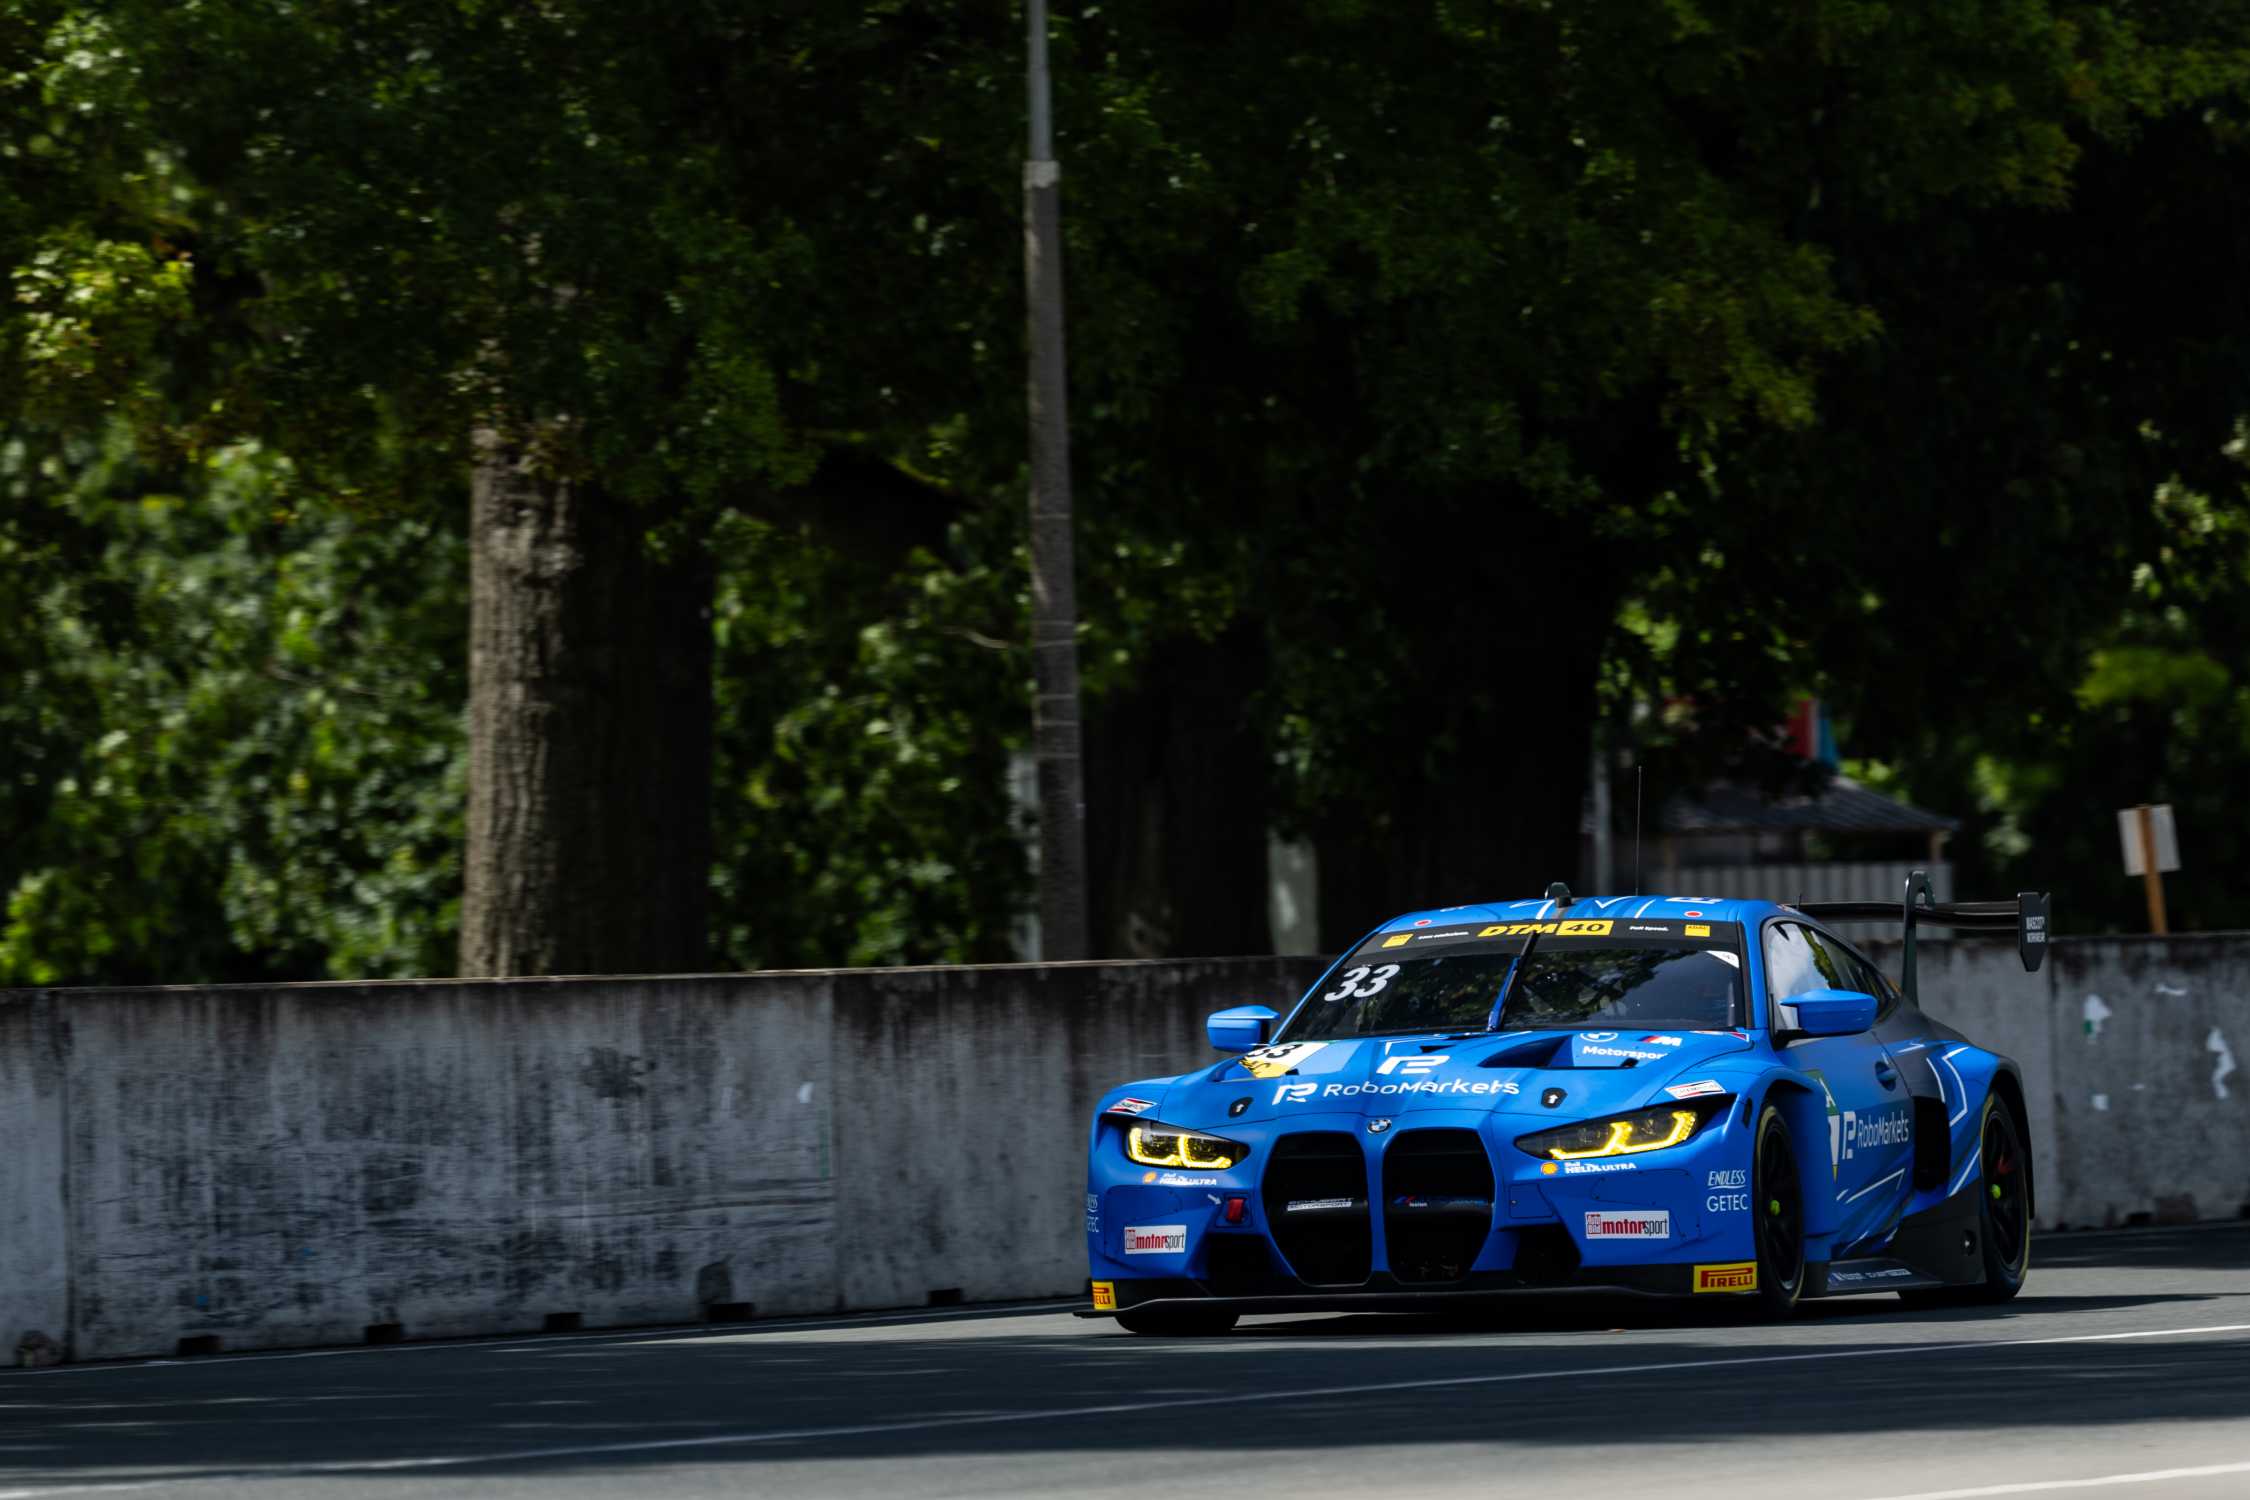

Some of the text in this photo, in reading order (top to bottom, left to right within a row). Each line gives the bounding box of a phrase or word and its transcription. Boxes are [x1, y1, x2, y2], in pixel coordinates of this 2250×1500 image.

[1477, 923, 1559, 937] DTM
[1565, 923, 1606, 932] 40
[1323, 964, 1401, 1002] 33
[1582, 1045, 1669, 1060] Motorspor
[1322, 1078, 1521, 1098] RoboMarkets
[1857, 1109, 1910, 1149] RoboMarkets
[1601, 1162, 1637, 1171] ULTRA
[1707, 1169, 1746, 1187] ENDLESS
[1706, 1194, 1749, 1212] GETEC
[1602, 1219, 1669, 1236] motorsport
[1136, 1233, 1185, 1250] motorsport
[1701, 1267, 1754, 1288] PIRELLI
